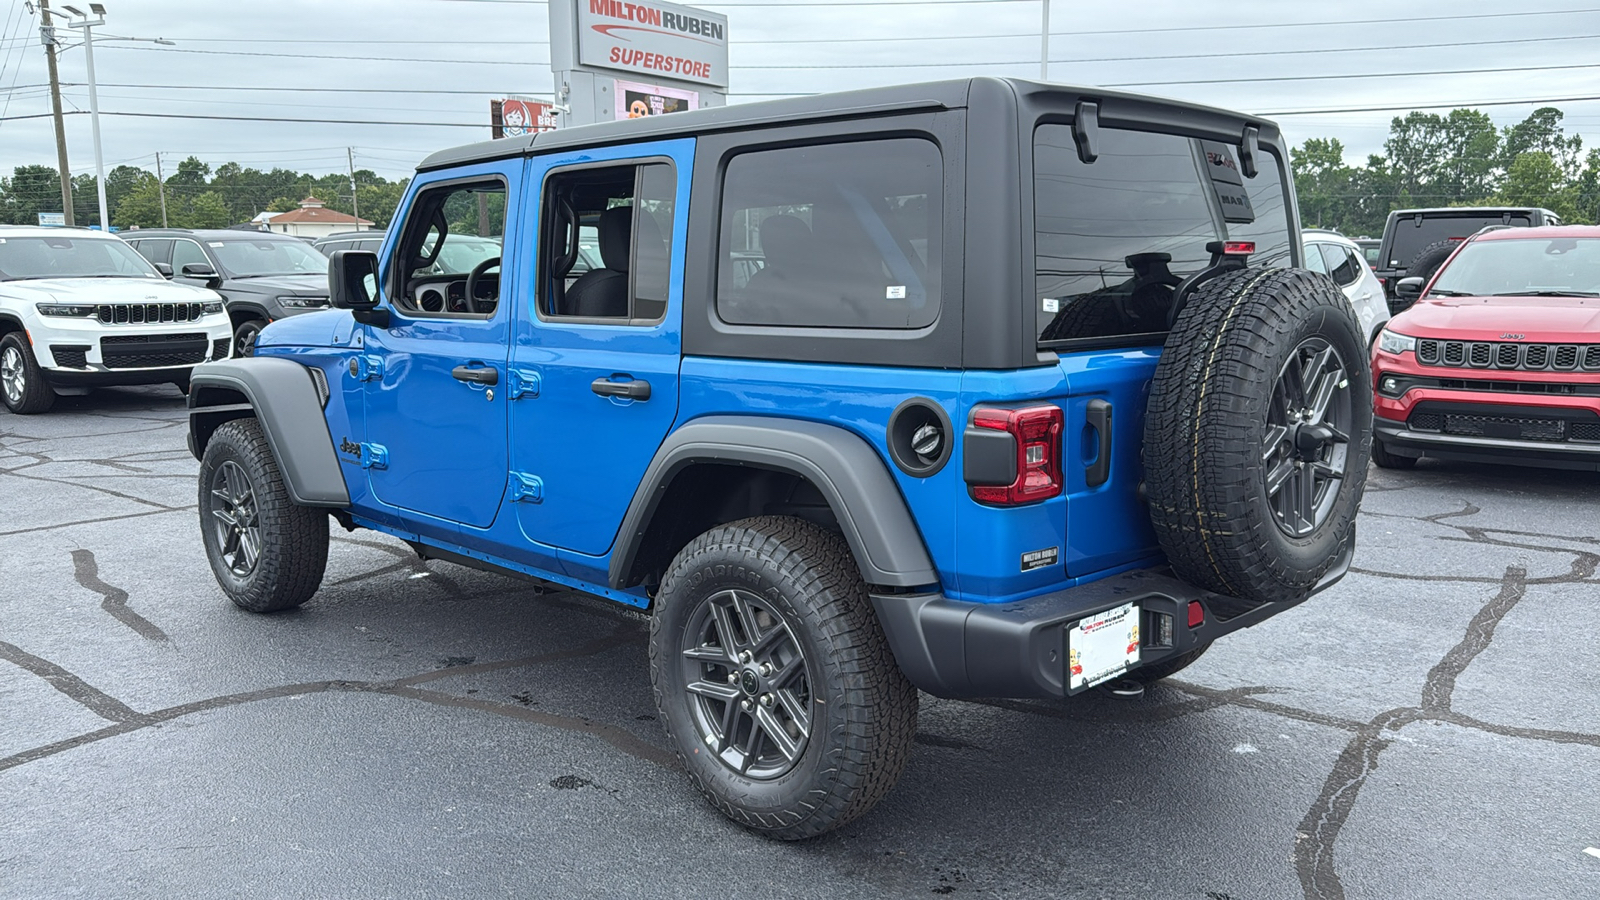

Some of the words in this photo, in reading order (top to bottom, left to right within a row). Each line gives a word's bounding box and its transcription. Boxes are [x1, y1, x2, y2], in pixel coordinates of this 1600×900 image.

[589, 0, 661, 27] MILTON
[662, 11, 723, 41] RUBEN
[609, 46, 711, 79] SUPERSTORE
[1499, 332, 1525, 340] Jeep
[340, 435, 362, 459] Jeep
